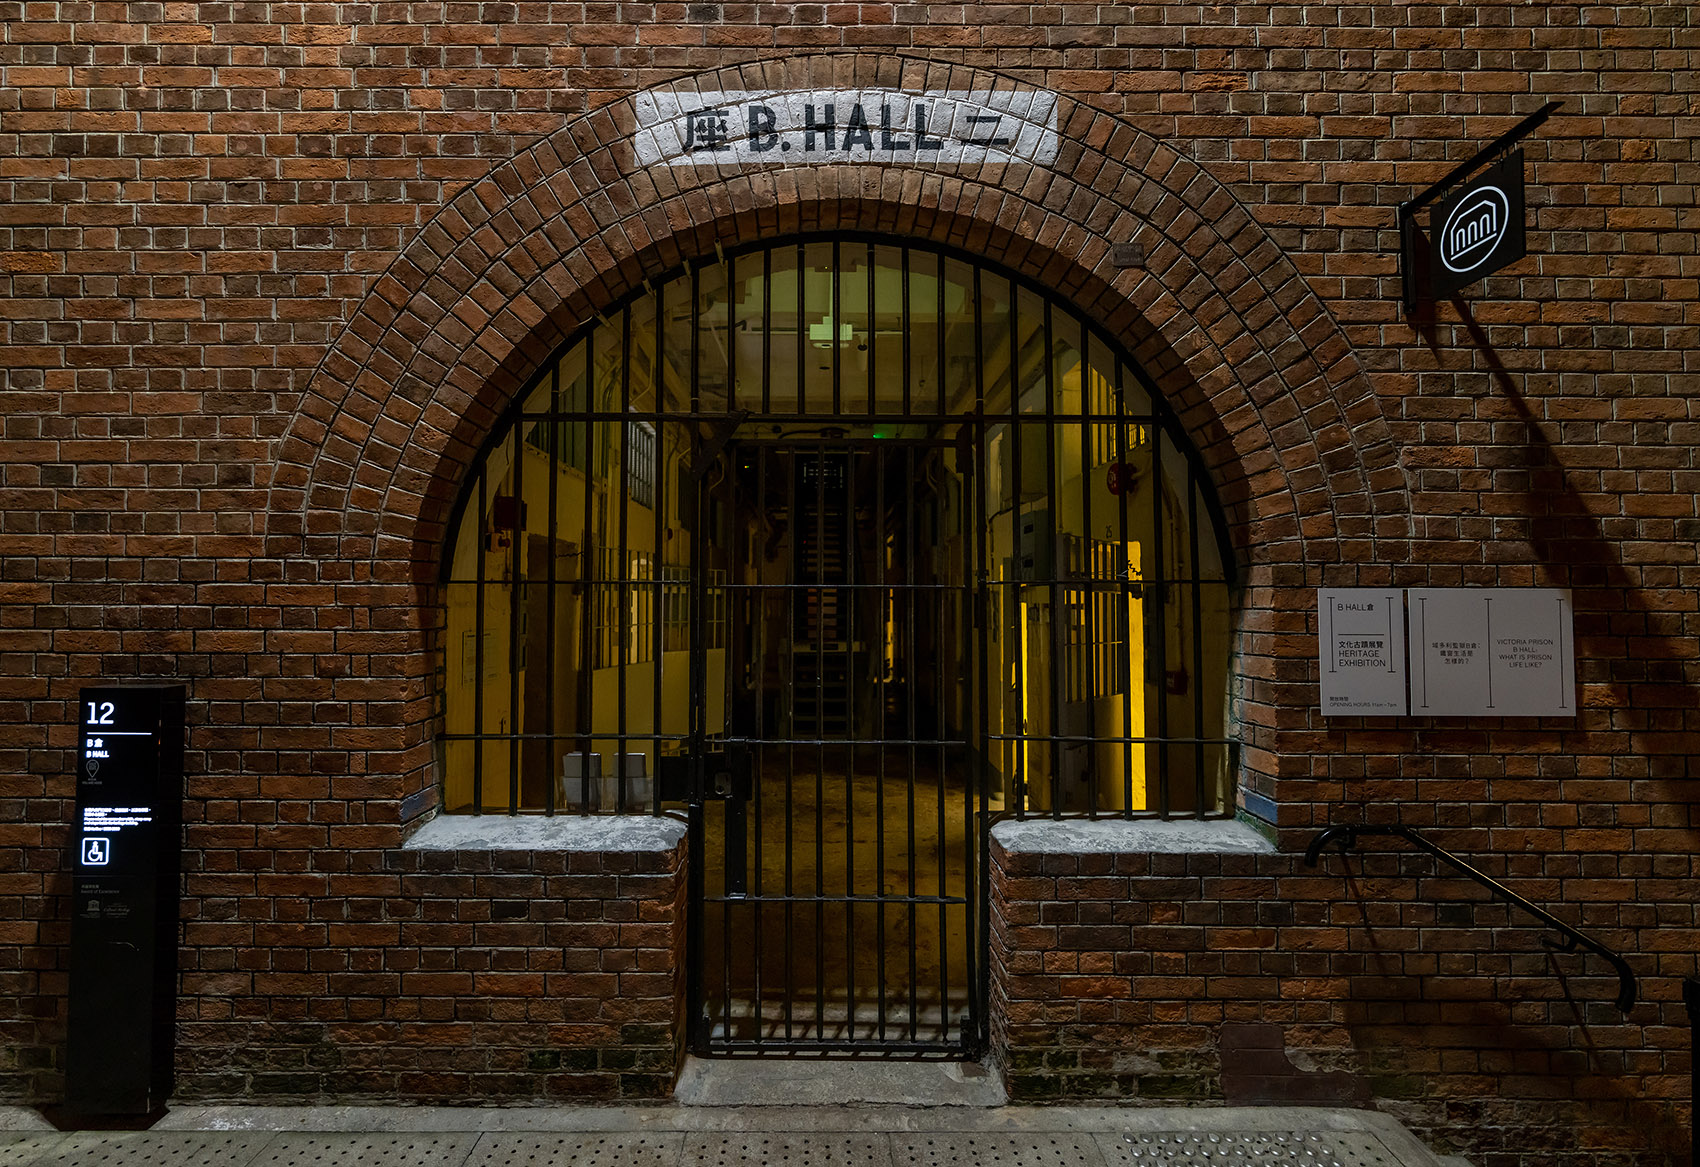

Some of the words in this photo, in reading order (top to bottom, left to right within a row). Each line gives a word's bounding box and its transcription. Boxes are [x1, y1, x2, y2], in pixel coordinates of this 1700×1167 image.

[682, 107, 730, 153] 座
[804, 103, 945, 152] HALL
[1339, 659, 1386, 667] EXHIBITION
[87, 702, 115, 725] 12
